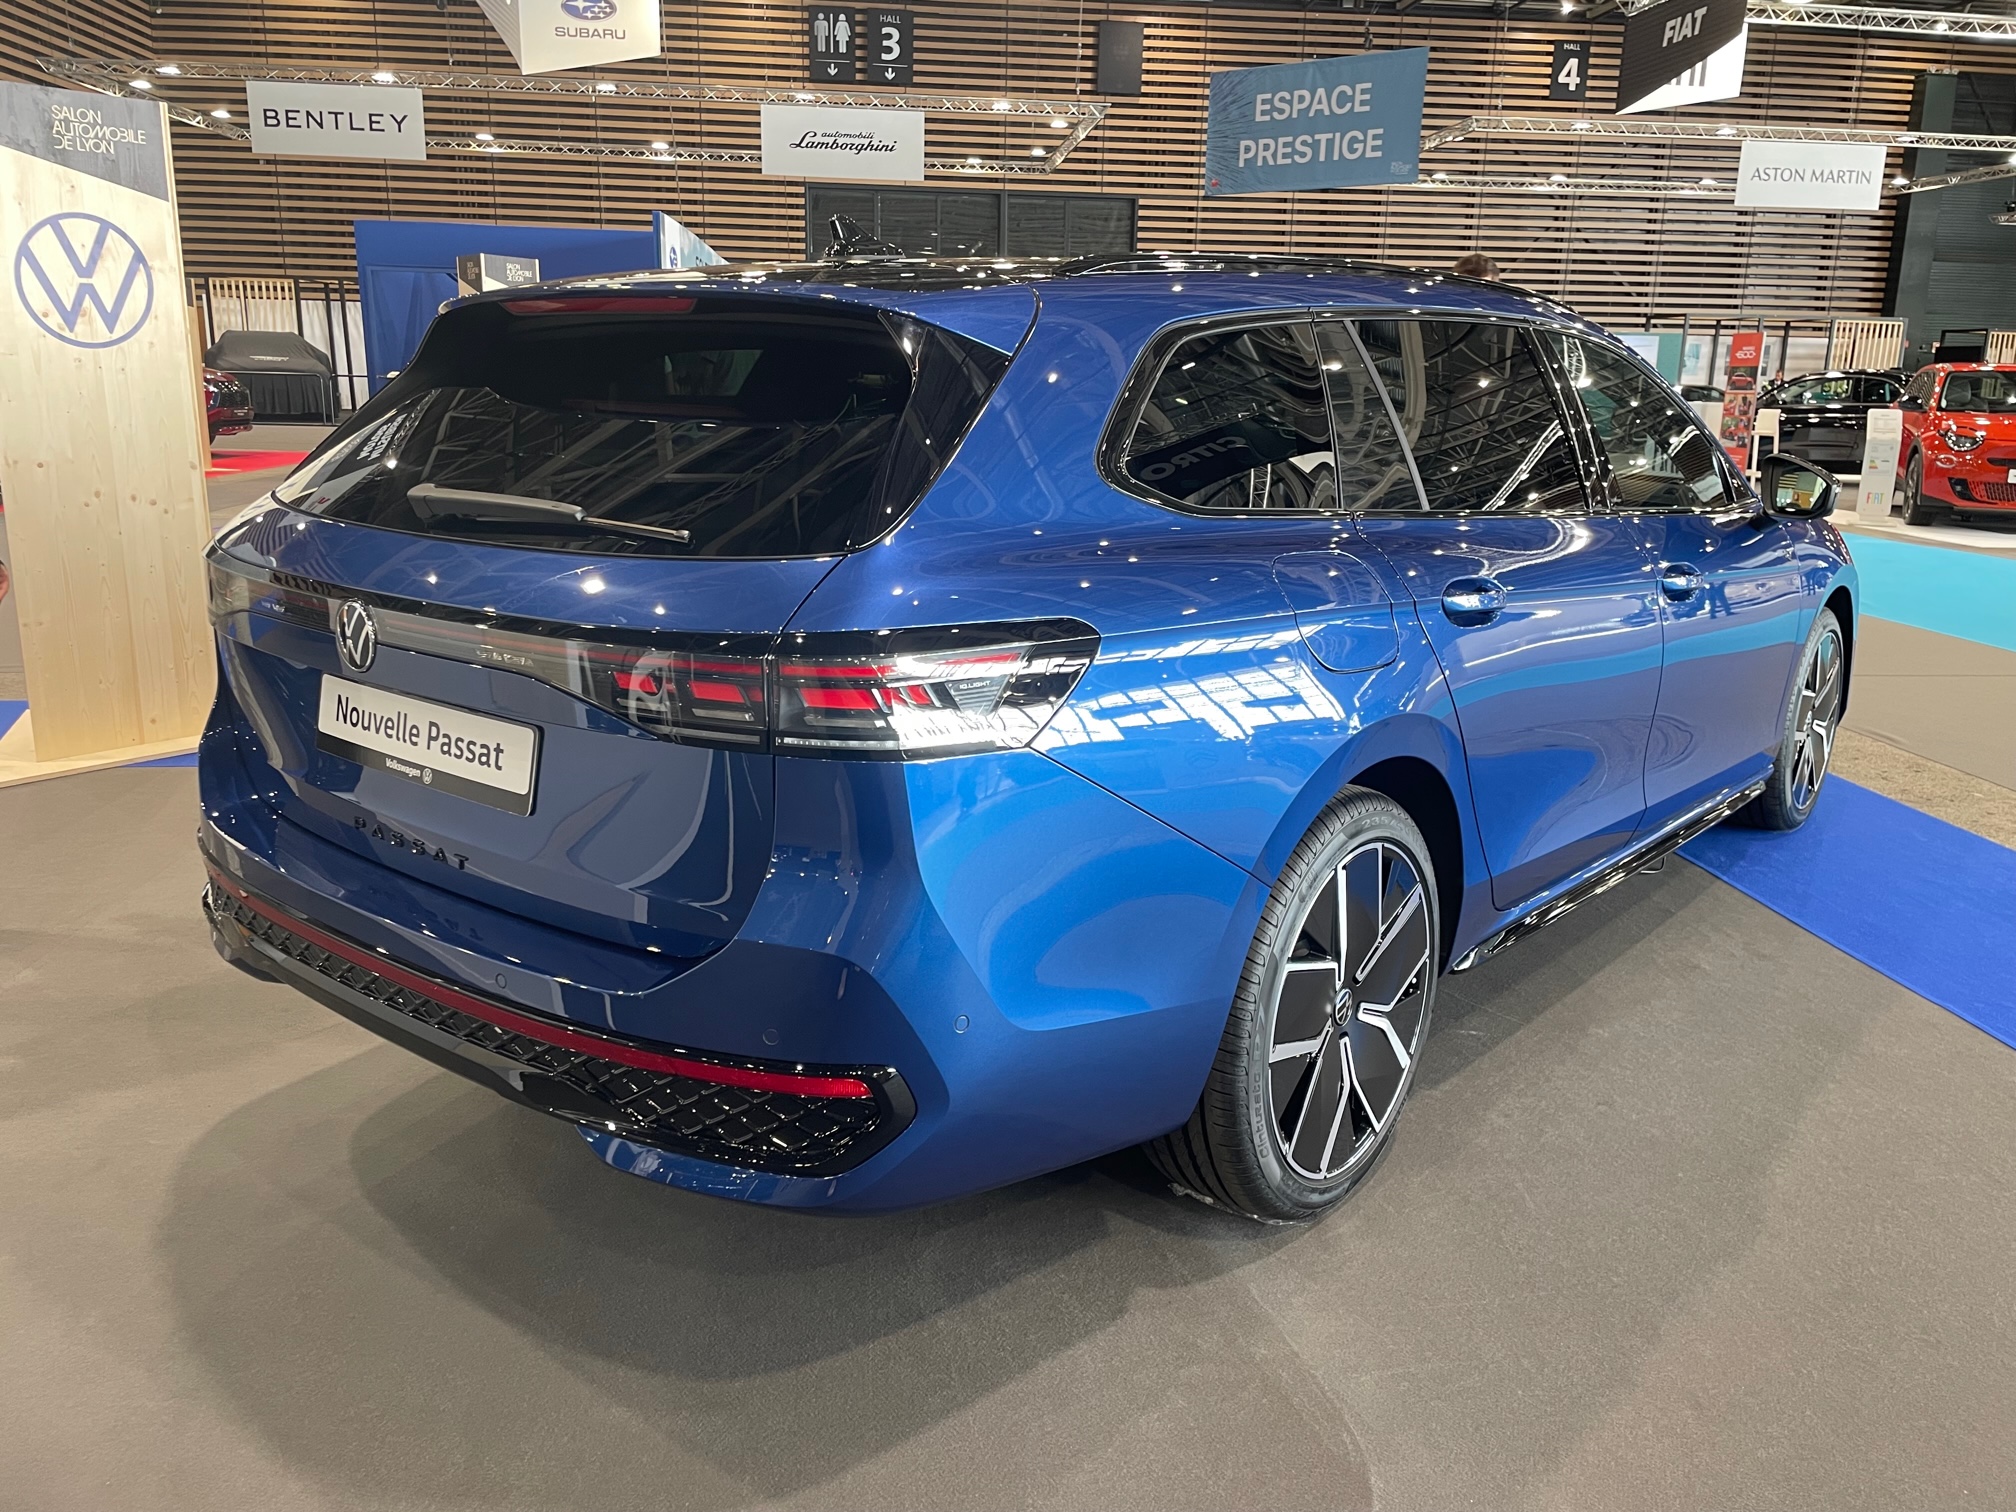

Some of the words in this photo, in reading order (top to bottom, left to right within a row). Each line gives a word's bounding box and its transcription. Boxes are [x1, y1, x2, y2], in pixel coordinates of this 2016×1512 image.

[879, 14, 901, 24] HALL
[1662, 6, 1708, 48] FIAT
[555, 26, 626, 40] SUBARU
[880, 27, 901, 61] 3
[1563, 42, 1581, 51] HALL
[1557, 57, 1581, 91] 4
[1254, 82, 1373, 122] ESPACE
[51, 104, 102, 125] SALON
[263, 108, 409, 133] BENTLEY
[52, 121, 147, 145] AUTOMOBILE
[53, 134, 74, 151] DE
[77, 136, 115, 155] LYON
[789, 130, 898, 155] Lamborghini
[820, 130, 875, 140] automobili
[1238, 128, 1384, 168] PRESTIGE
[1750, 167, 1806, 183] ASTON
[1810, 168, 1872, 185] MARTIN
[1866, 492, 1886, 505] FIAT
[335, 693, 420, 747] Nouvelle
[426, 720, 504, 772] Passat
[385, 757, 421, 778] Volkswagen
[354, 815, 469, 871] PASSAT
